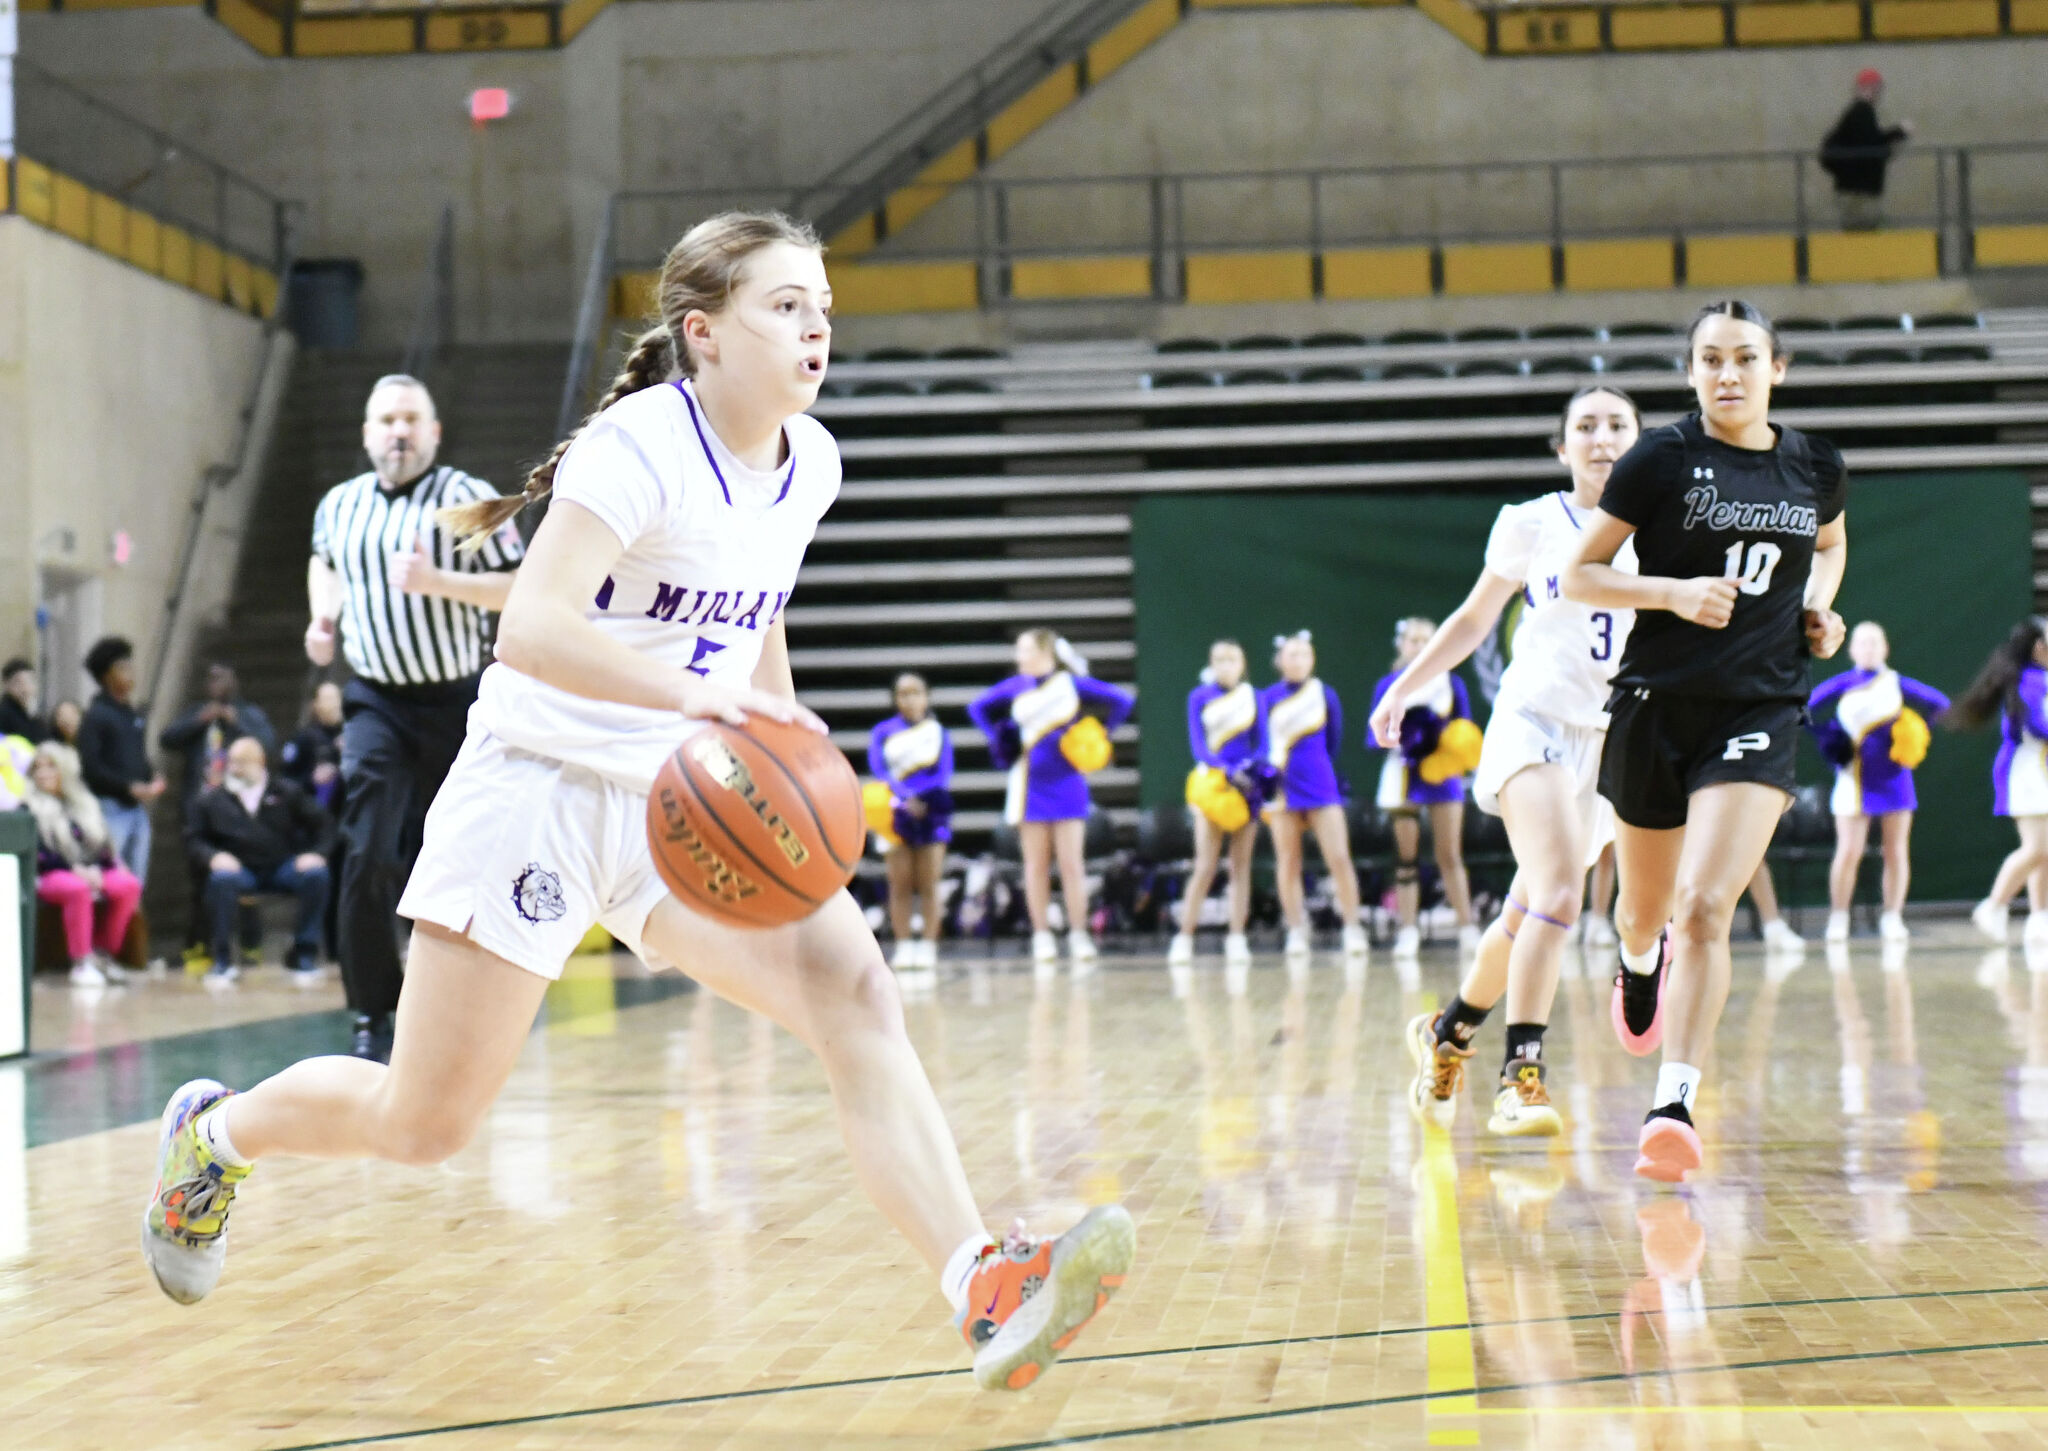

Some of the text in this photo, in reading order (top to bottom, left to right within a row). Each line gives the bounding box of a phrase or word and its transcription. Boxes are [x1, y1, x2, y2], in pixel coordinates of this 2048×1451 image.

[1683, 484, 1818, 537] Permian
[1723, 540, 1782, 596] 10
[1590, 612, 1613, 662] 3
[1722, 731, 1771, 761] P
